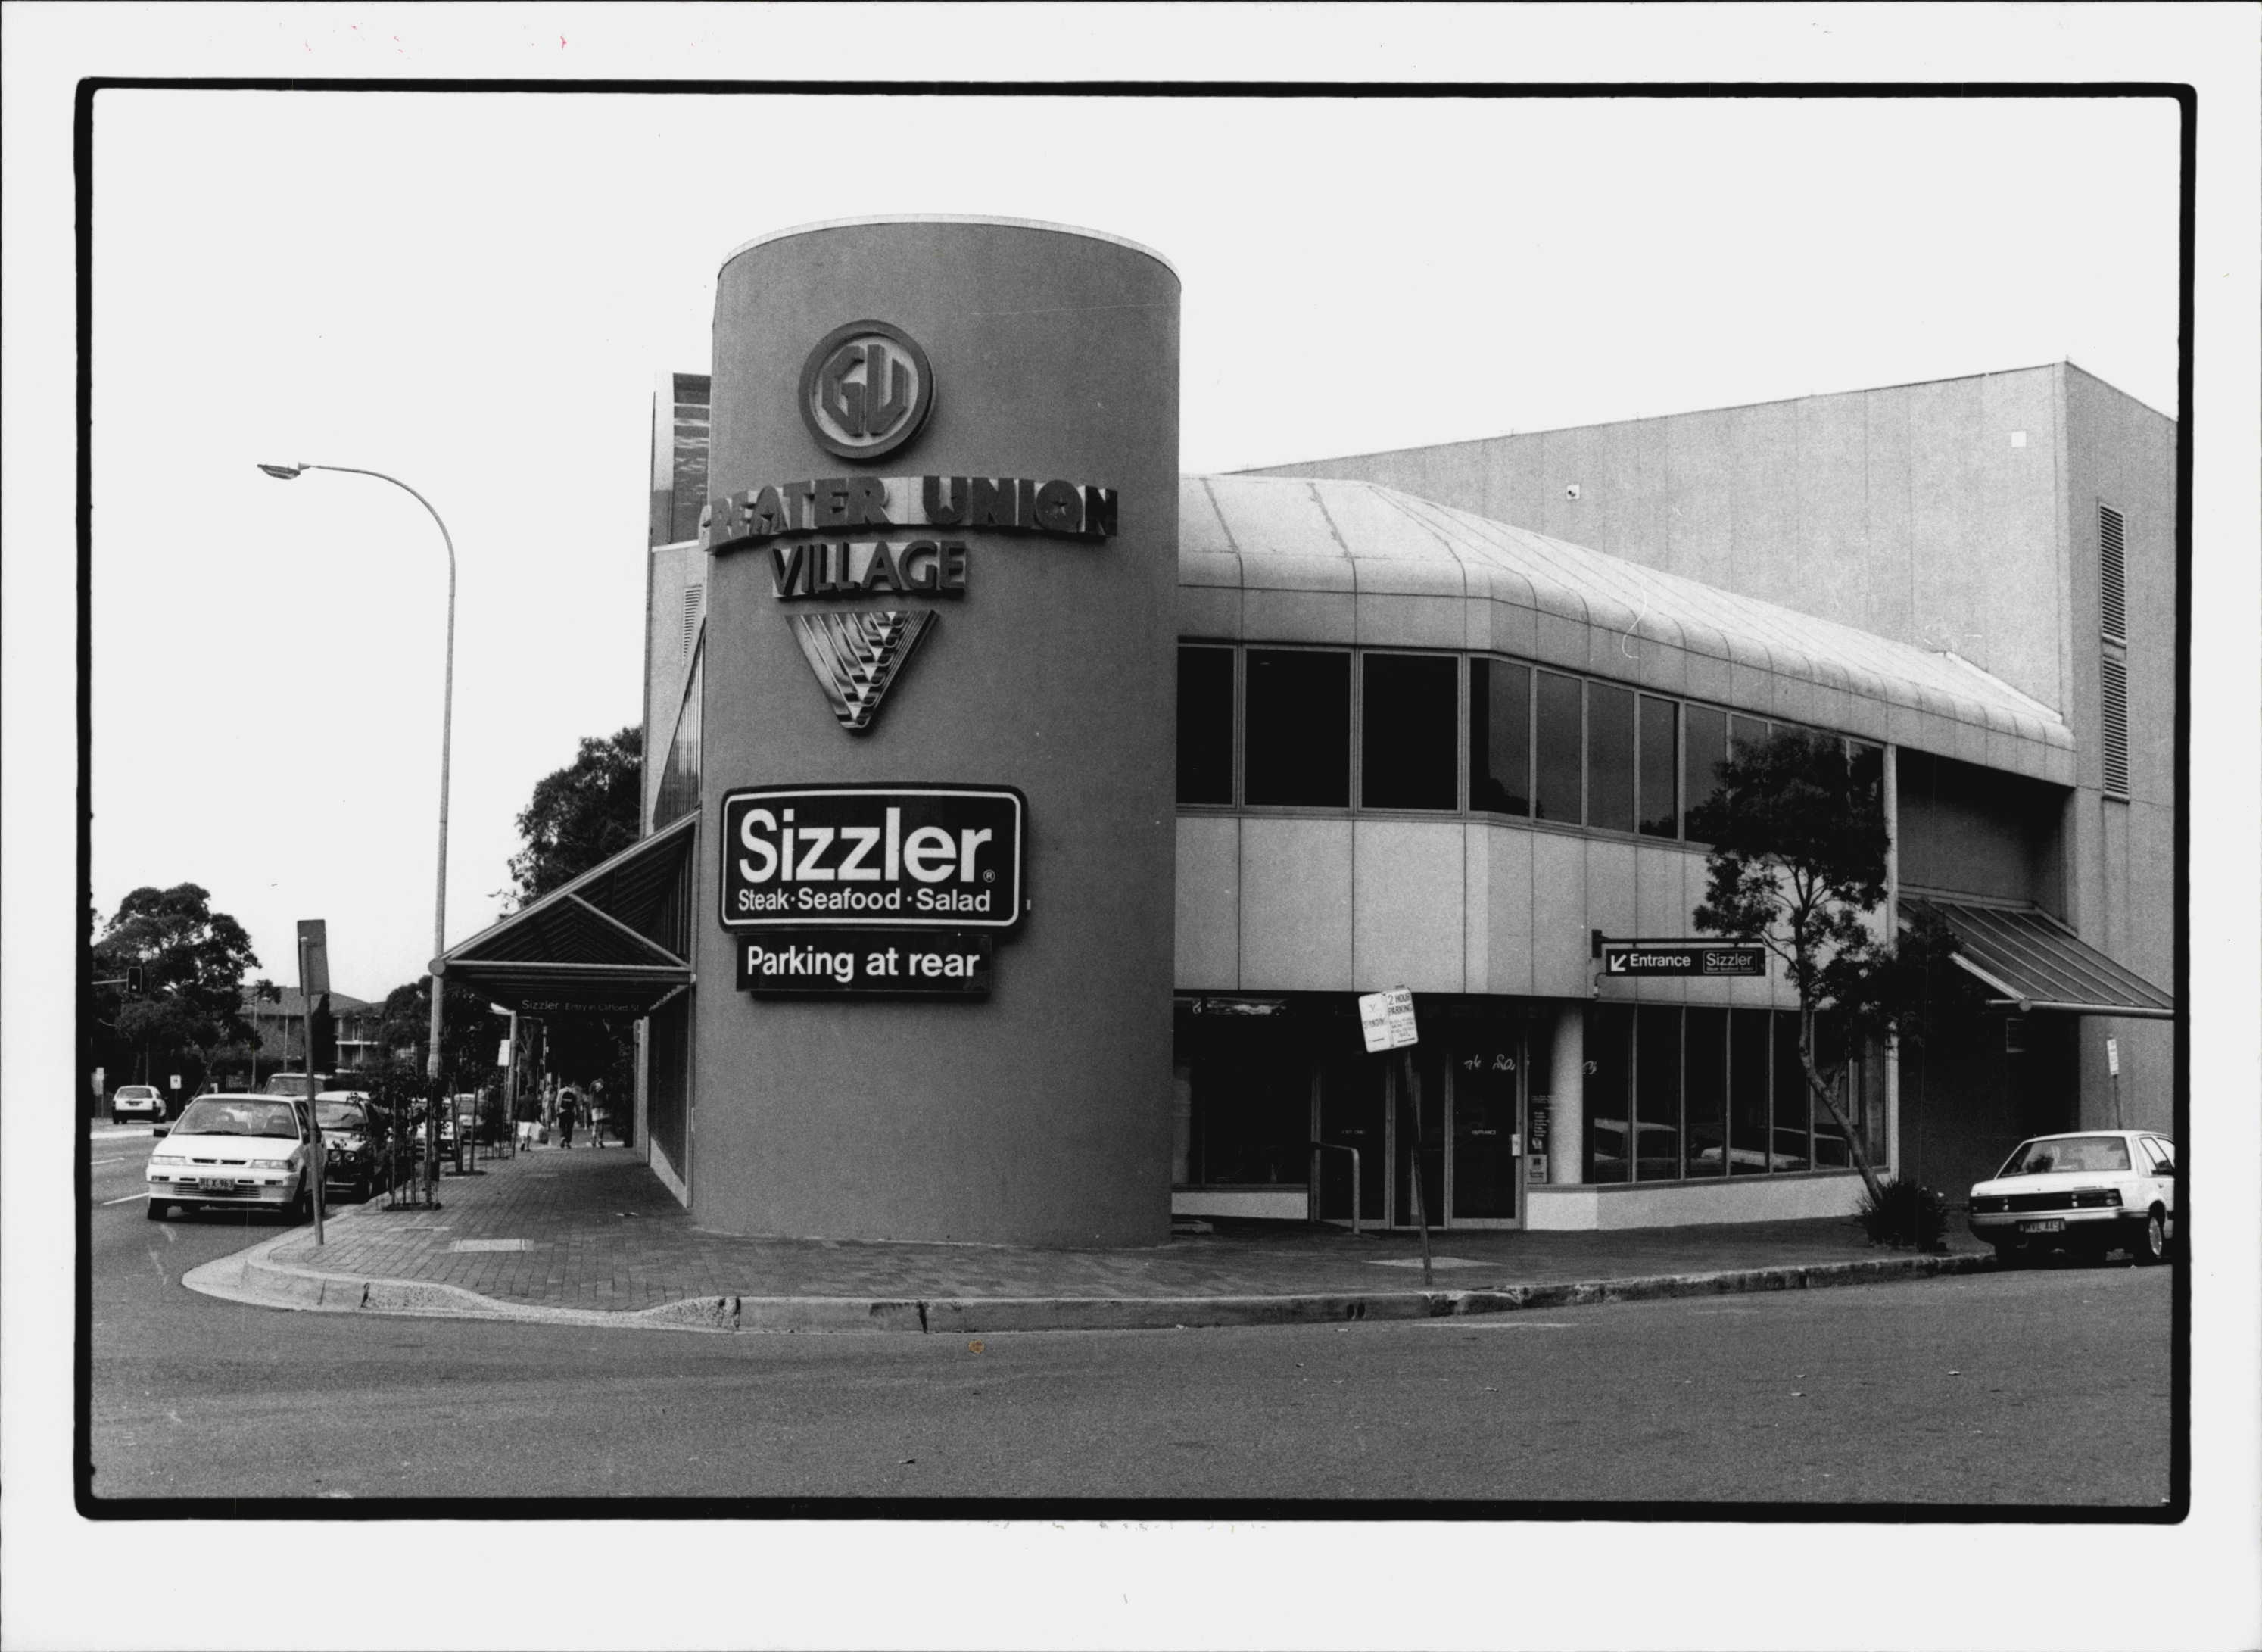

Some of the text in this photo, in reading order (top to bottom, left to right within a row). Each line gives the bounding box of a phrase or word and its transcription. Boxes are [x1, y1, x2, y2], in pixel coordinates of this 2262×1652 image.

[921, 475, 1118, 536] UNION
[768, 540, 967, 598] VILLAGE
[747, 946, 980, 982] Parking at rear
[1630, 953, 1691, 967] Entrance
[1706, 952, 1753, 967] Sizzler
[522, 999, 559, 1011] Sizzler
[1388, 994, 1394, 1005] 2
